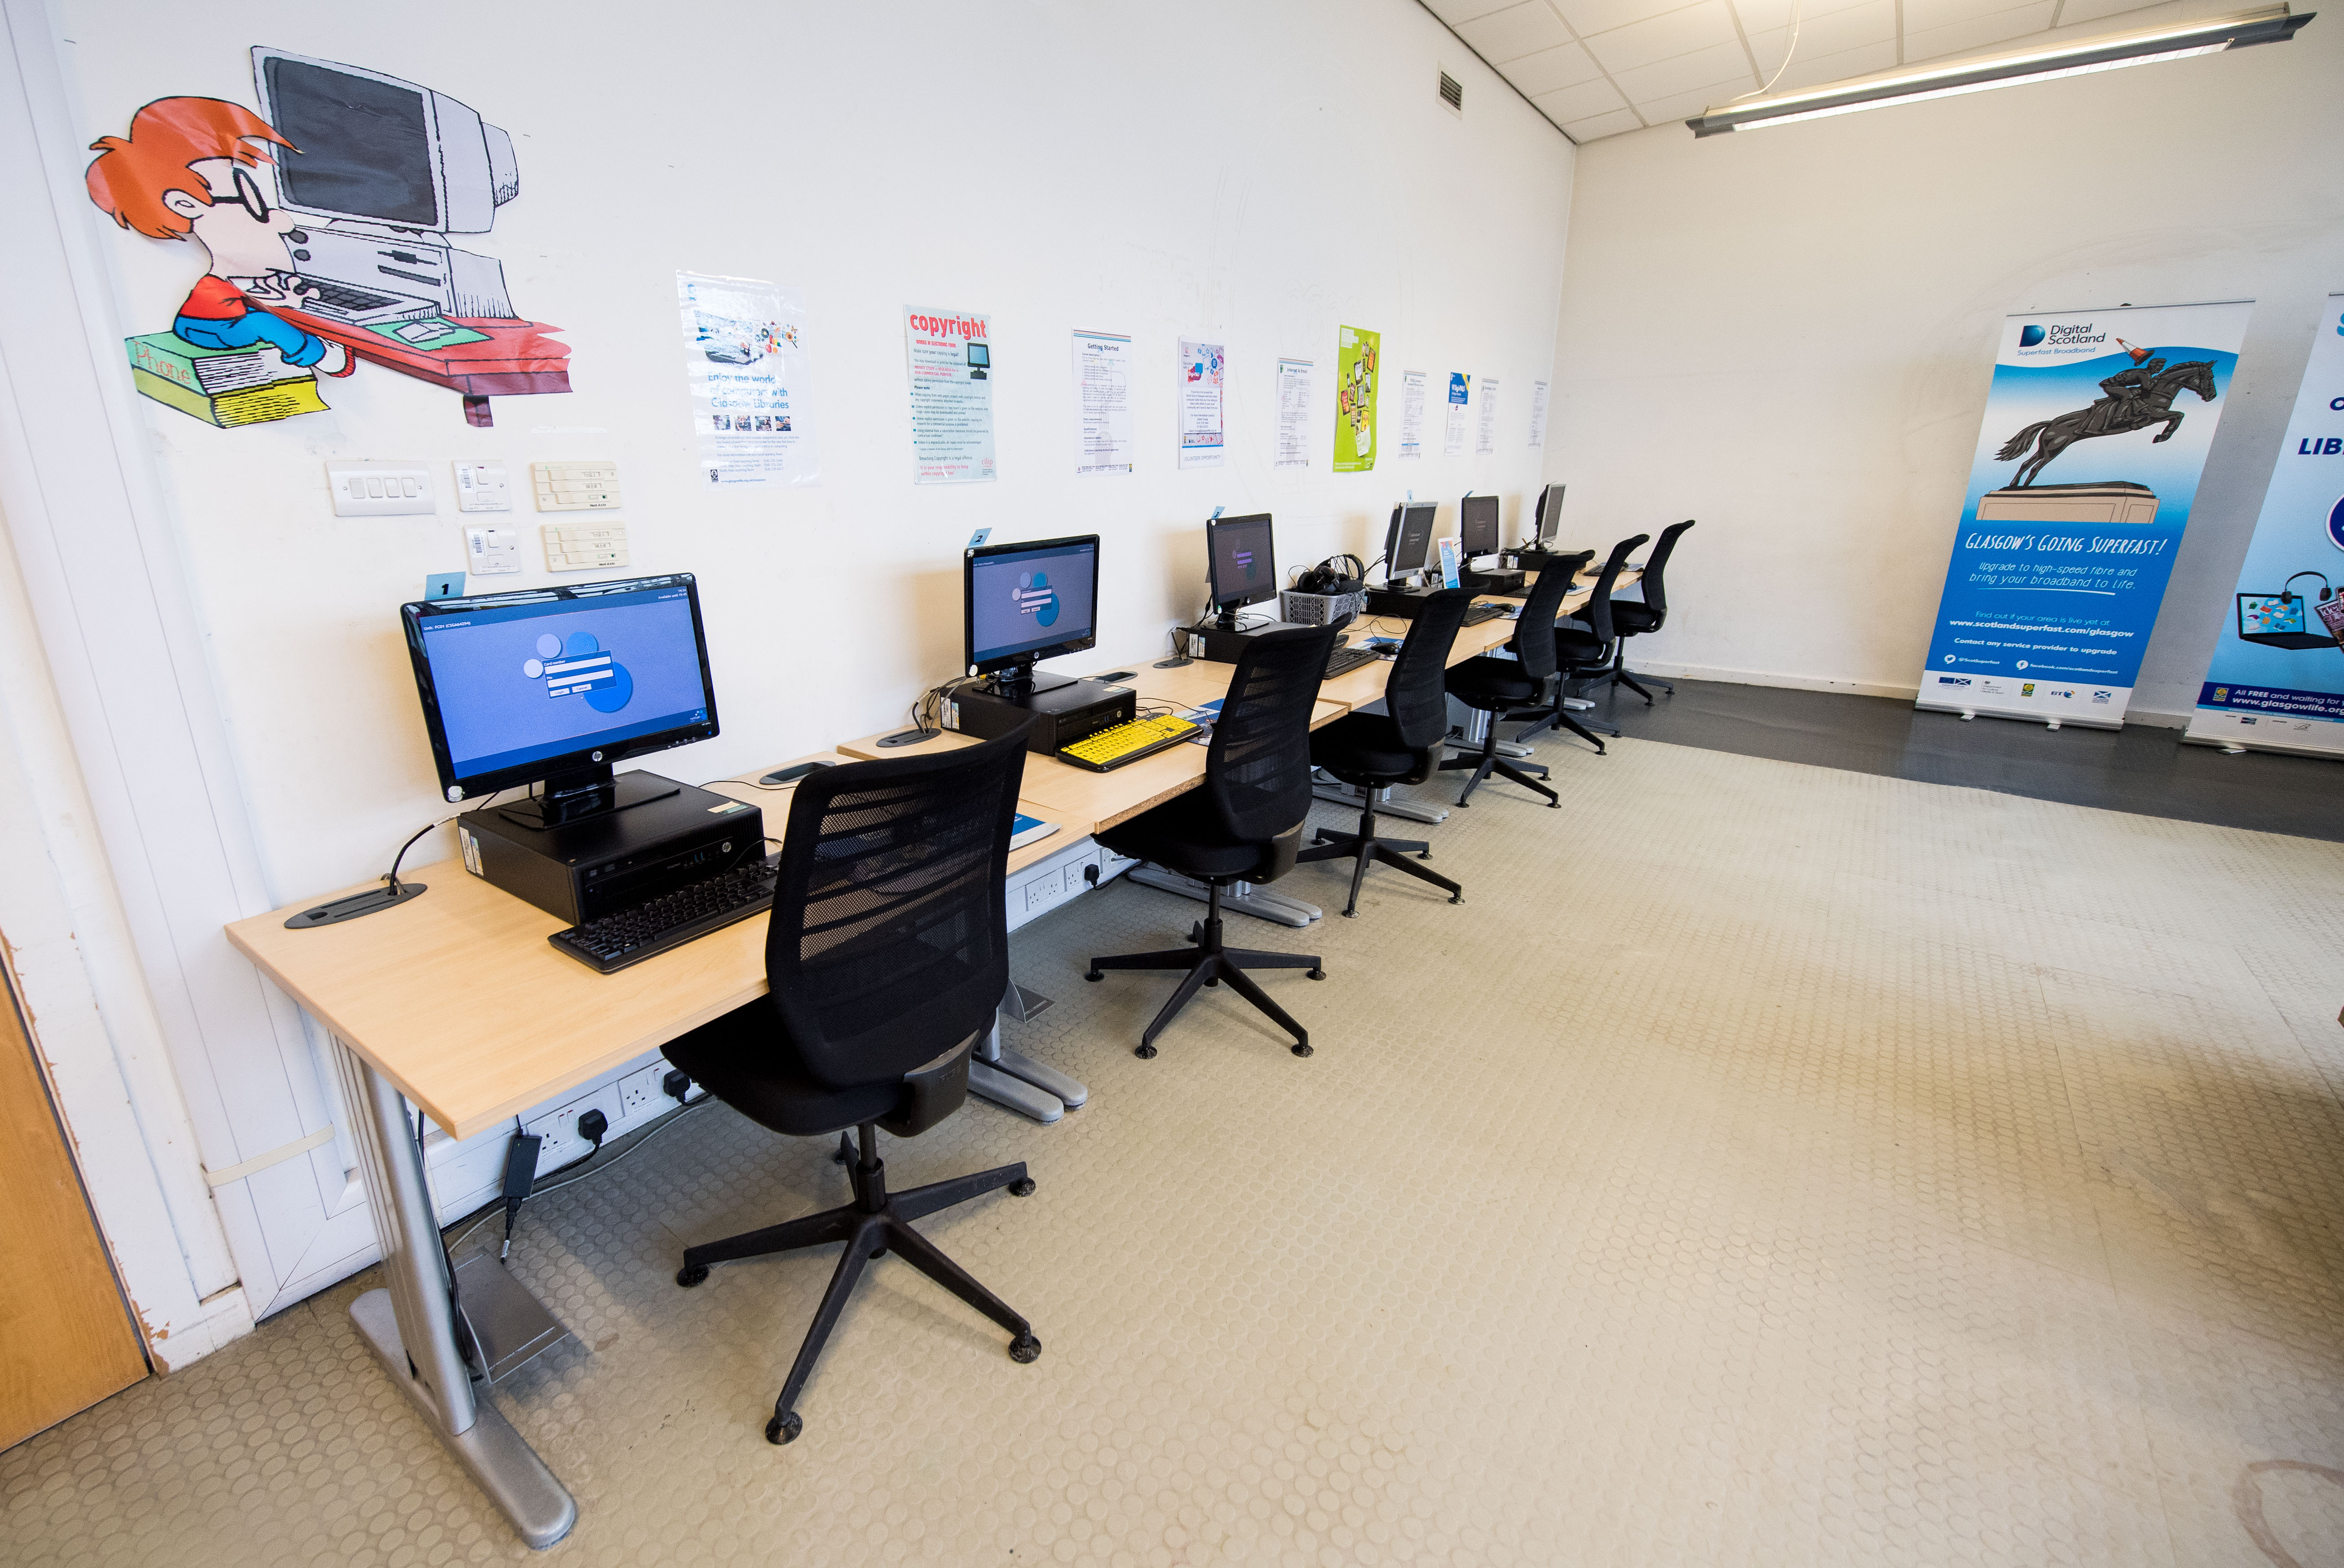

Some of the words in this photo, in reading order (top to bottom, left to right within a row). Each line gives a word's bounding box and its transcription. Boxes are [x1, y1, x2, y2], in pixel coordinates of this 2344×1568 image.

[910, 314, 987, 340] copyright
[2051, 323, 2093, 337] Digital
[2048, 333, 2106, 345] Scotland
[2017, 348, 2052, 356] Superfast
[132, 339, 191, 385] Phone
[708, 373, 732, 383] Enjoy
[735, 374, 749, 383] the
[752, 375, 776, 383] world
[2298, 438, 2344, 454] LIB
[1966, 533, 2036, 550] GLASGOW'S
[2038, 535, 2084, 551] GOING
[2087, 536, 2168, 555] SUPERFAST!
[1979, 562, 2015, 571] Upgrade
[2033, 564, 2088, 575] high-speed
[2090, 566, 2115, 575] fibre
[2118, 568, 2137, 577] and
[1969, 573, 1997, 584] bring
[2001, 576, 2026, 586] your
[2030, 576, 2091, 587] broadband
[2095, 579, 2108, 588] to
[2112, 580, 2136, 589] life.
[441, 583, 449, 595] 1
[1950, 620, 2134, 637] www.scotlandsuperfast.com/glasgow
[2030, 663, 2118, 674] facebook.com/scotlandsuperfast
[2291, 695, 2325, 704] waiting
[2233, 698, 2344, 716] www.glasgowlife.org
[593, 752, 602, 761] hp
[722, 842, 731, 852] hp
